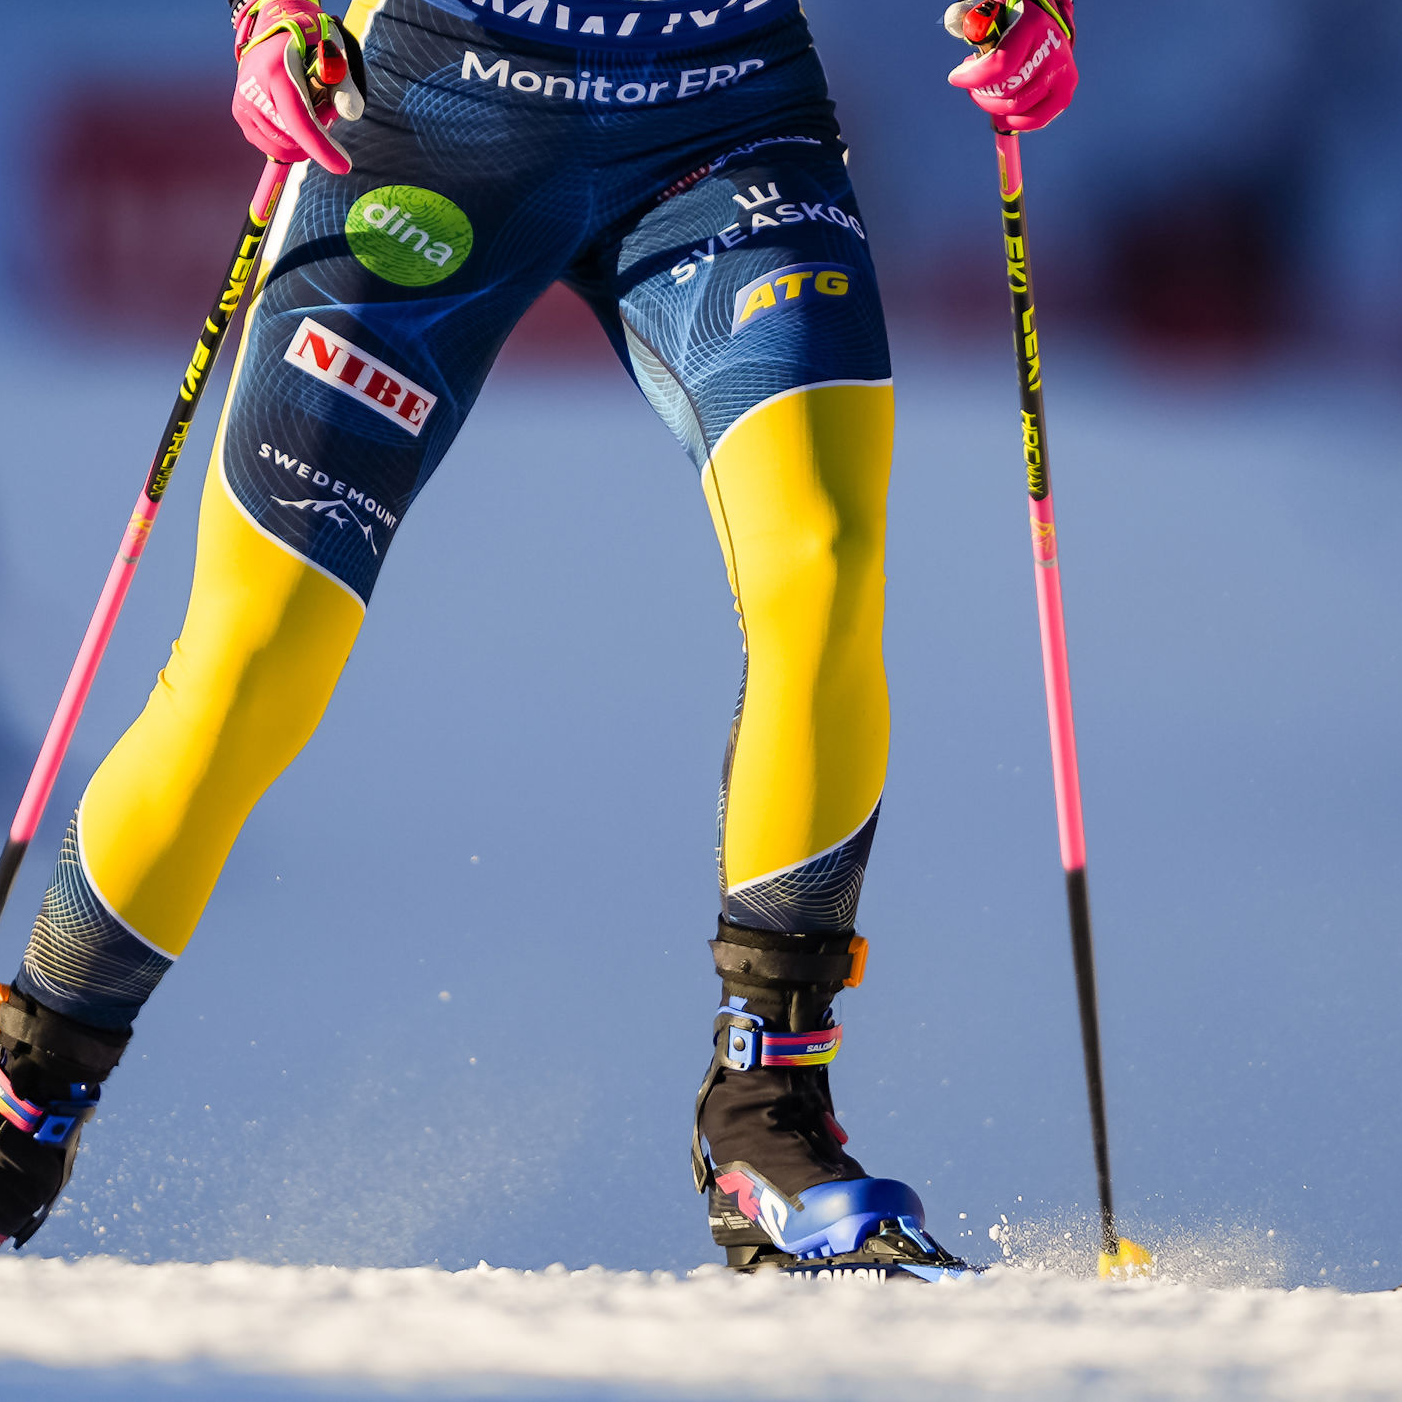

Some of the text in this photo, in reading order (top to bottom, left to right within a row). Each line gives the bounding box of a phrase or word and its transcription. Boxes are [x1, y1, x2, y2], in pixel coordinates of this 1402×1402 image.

[460, 50, 671, 105] Monitor
[362, 202, 454, 268] dina
[670, 201, 866, 286] SVEASKOG
[737, 270, 849, 324] ATG
[293, 327, 430, 427] NIBE
[257, 442, 398, 530] SWEDEMOUNT
